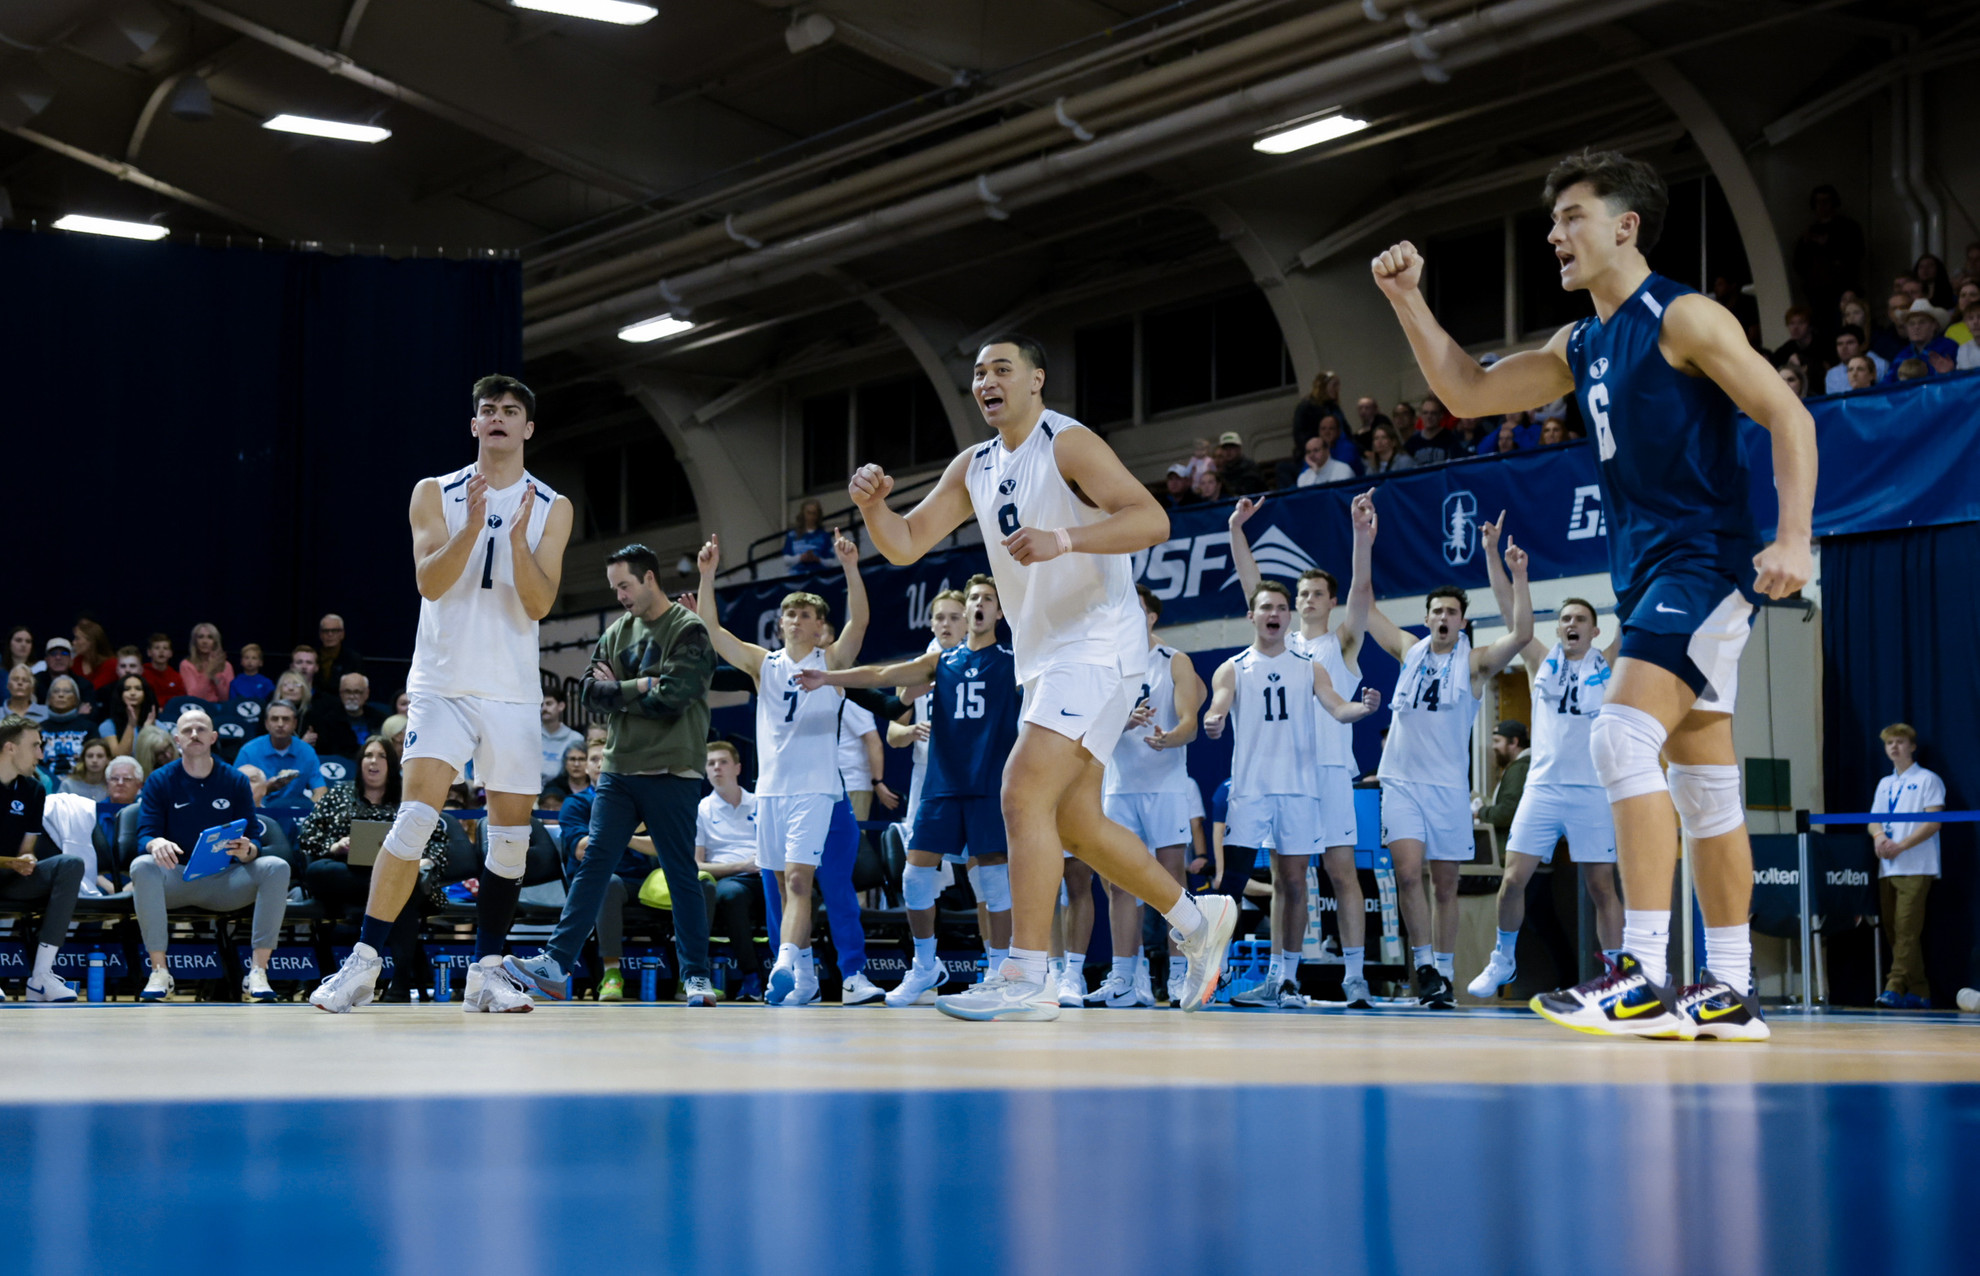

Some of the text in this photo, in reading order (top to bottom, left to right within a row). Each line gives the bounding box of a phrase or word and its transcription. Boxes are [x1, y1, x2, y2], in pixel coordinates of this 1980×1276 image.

[1588, 382, 1617, 462] 6
[481, 537, 494, 589] 1
[783, 691, 798, 722] 7
[954, 681, 986, 719] 15
[1263, 686, 1288, 721] 11
[1413, 677, 1440, 712] 14
